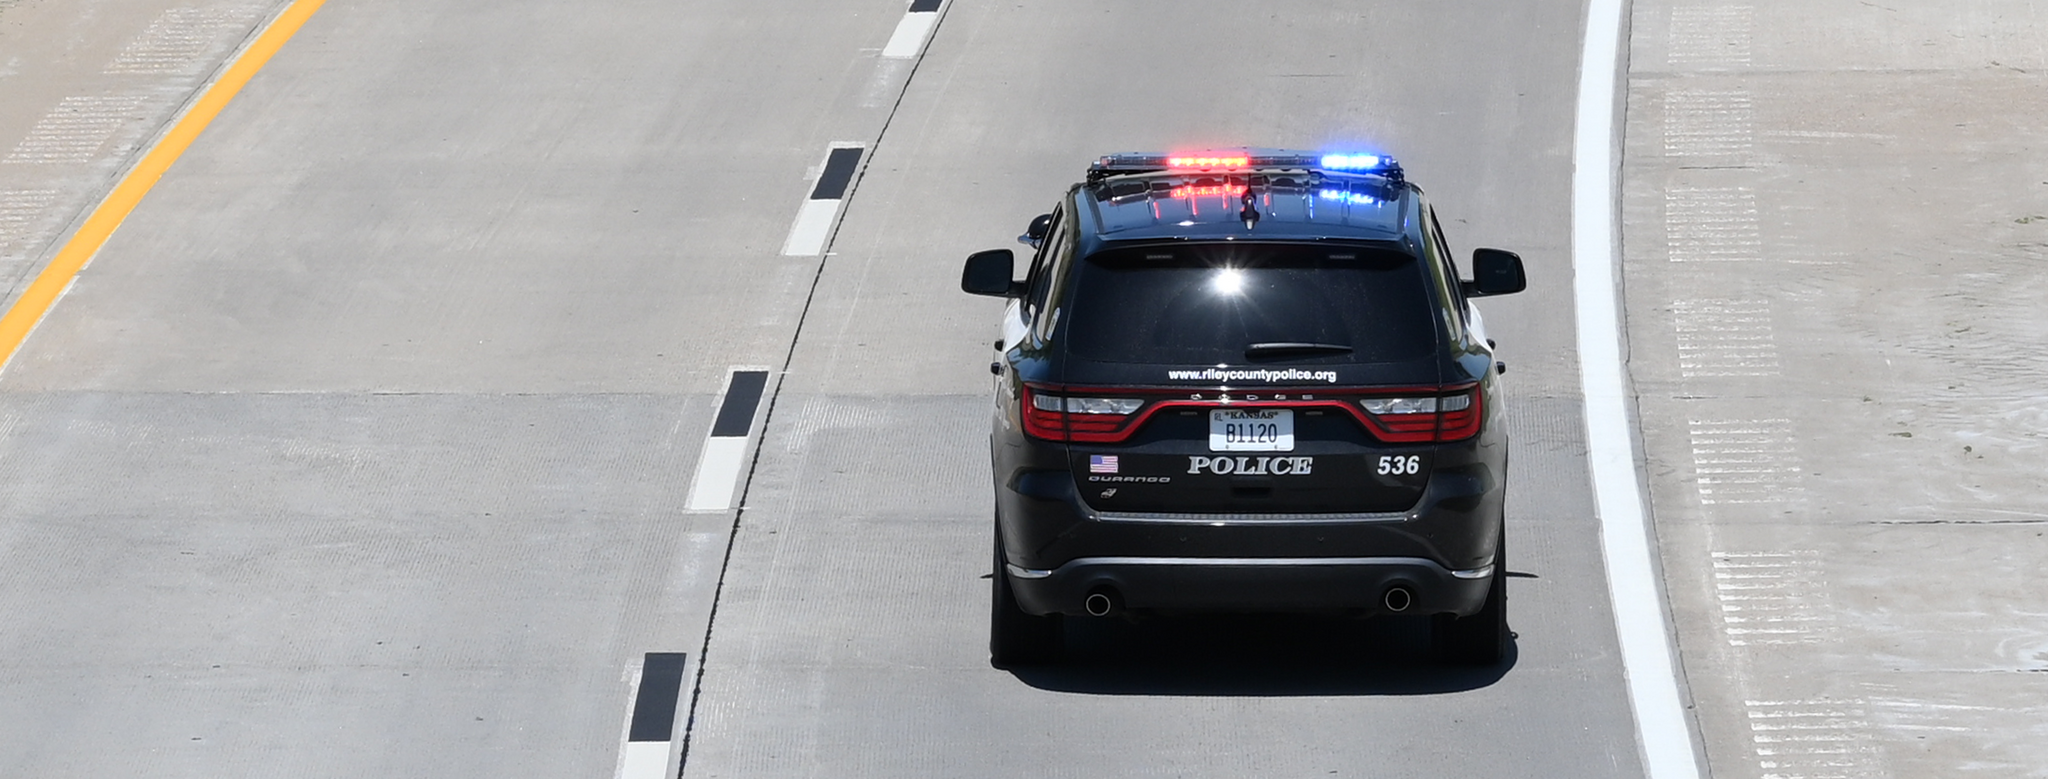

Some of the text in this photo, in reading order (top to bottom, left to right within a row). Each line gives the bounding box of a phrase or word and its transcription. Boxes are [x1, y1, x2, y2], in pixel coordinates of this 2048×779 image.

[1168, 369, 1337, 382] www.rileycountypolice.org
[1226, 423, 1278, 443] B1120
[1187, 456, 1313, 475] POLICE
[1377, 455, 1420, 475] 536
